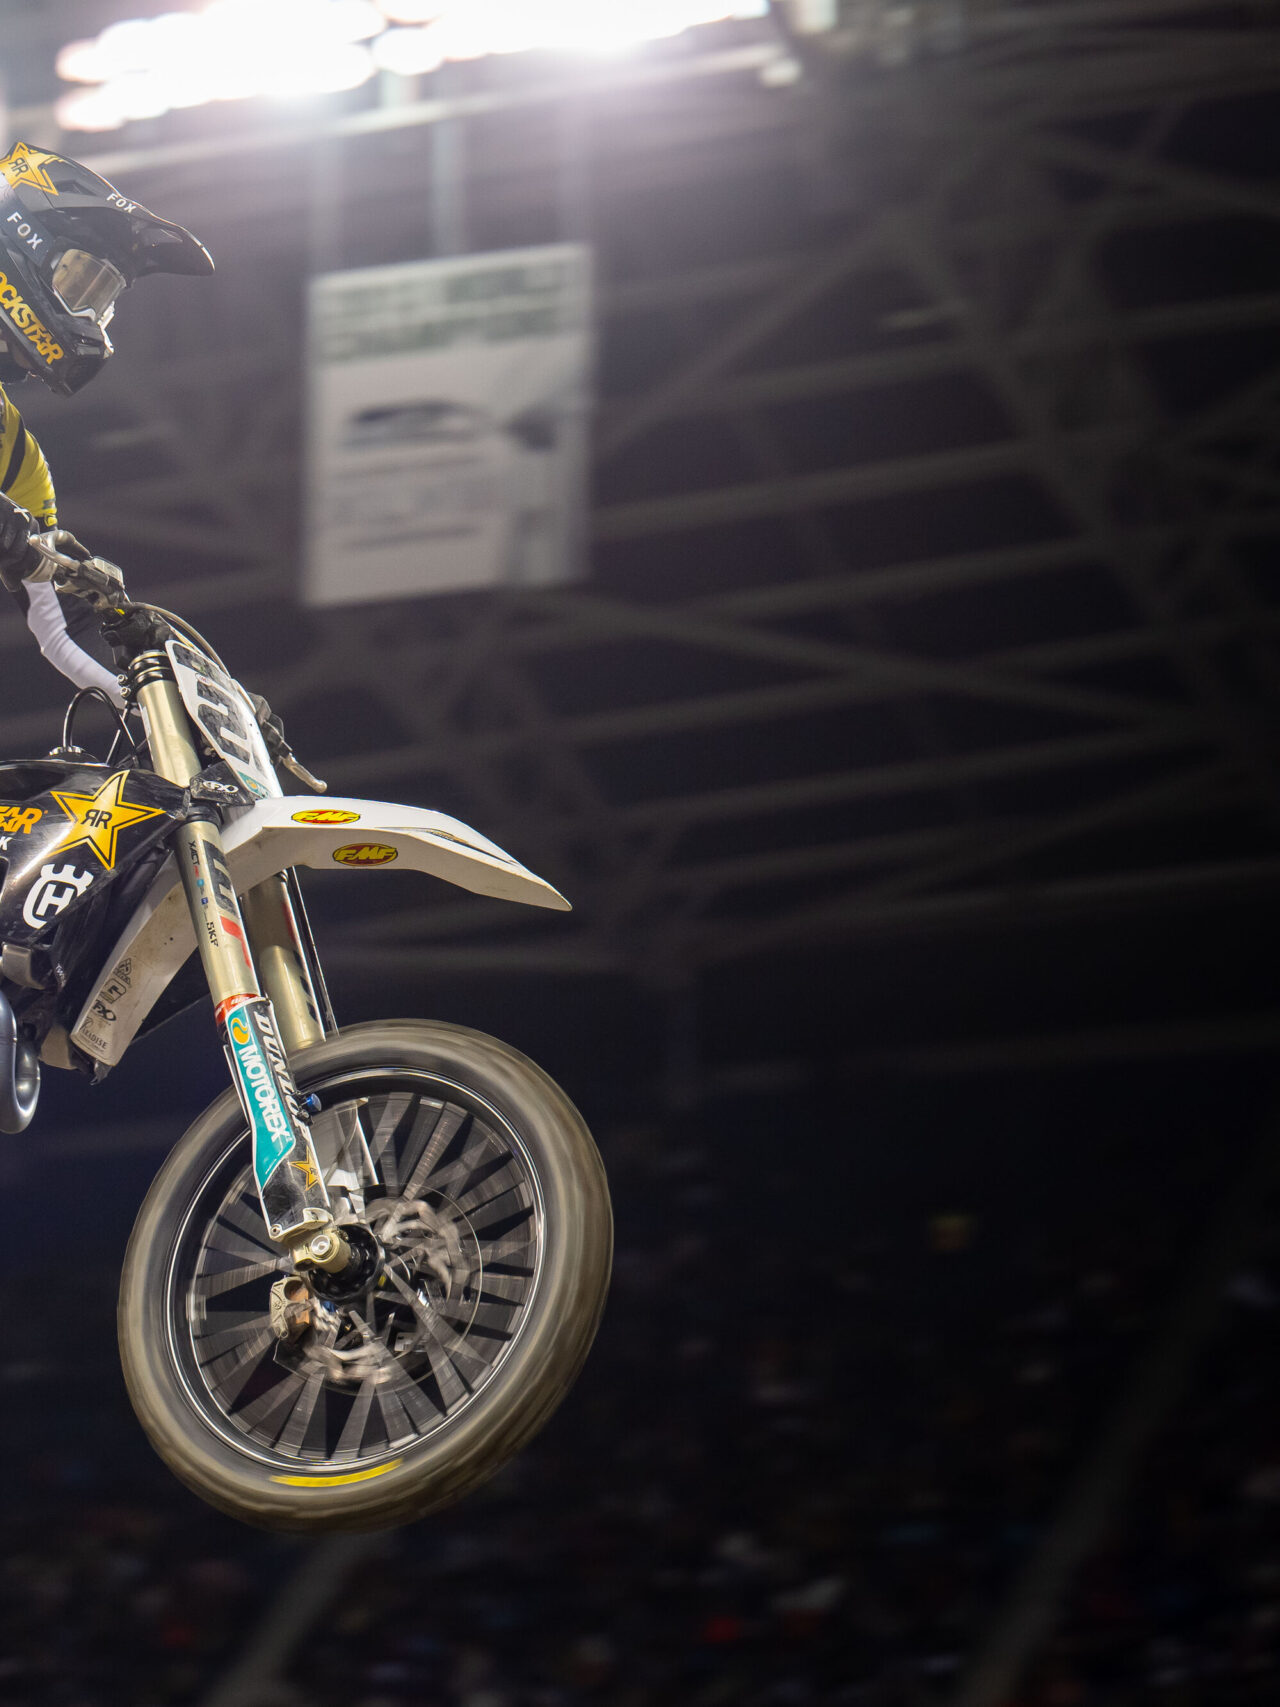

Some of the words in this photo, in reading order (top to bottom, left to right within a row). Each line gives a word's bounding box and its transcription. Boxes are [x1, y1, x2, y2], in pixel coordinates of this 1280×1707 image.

[106, 193, 137, 213] FOX
[7, 211, 43, 250] FOX
[292, 811, 360, 822] FMF
[333, 845, 397, 862] FMF
[206, 921, 219, 947] SKF
[253, 1011, 310, 1142] DUNLOP
[238, 1044, 290, 1143] MOTOREX
